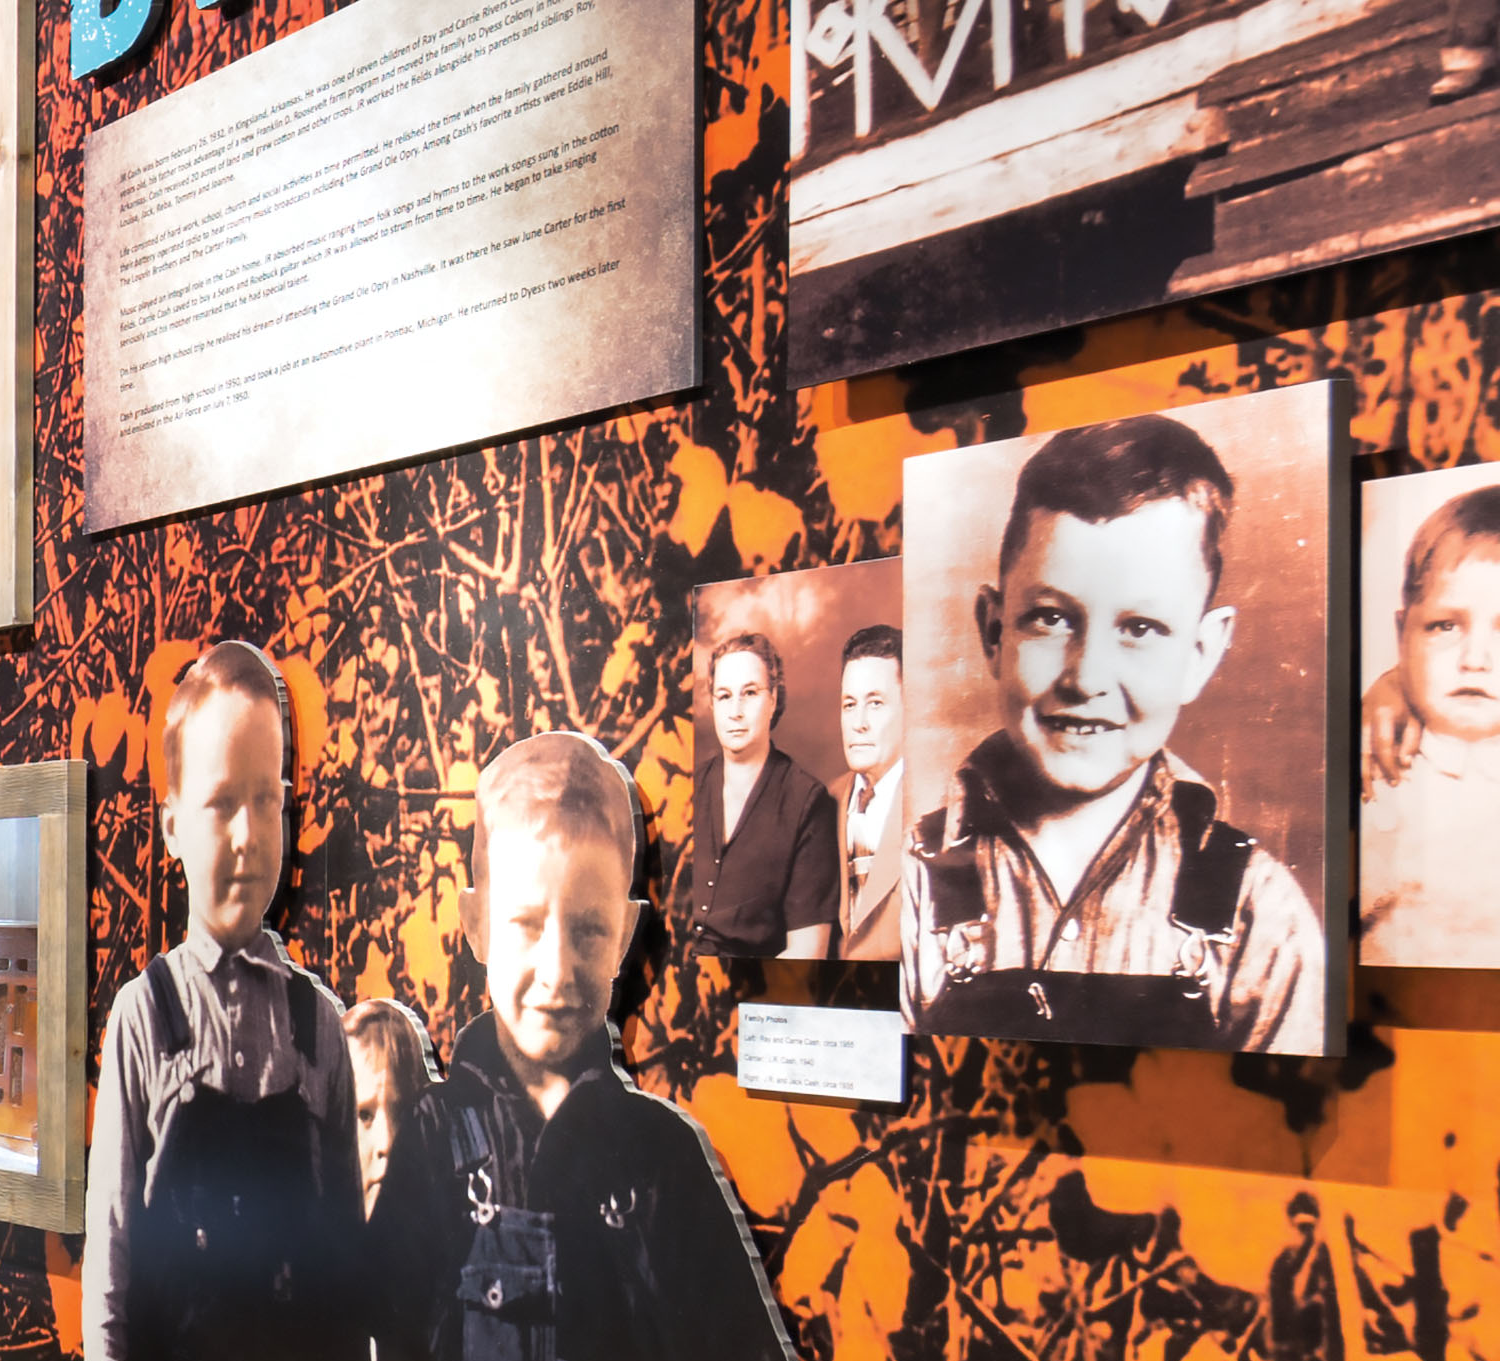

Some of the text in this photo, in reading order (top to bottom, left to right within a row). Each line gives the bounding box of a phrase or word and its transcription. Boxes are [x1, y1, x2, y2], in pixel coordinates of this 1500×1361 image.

[396, 0, 595, 93] the fields alongside his parents and siblings Roy,
[397, 53, 423, 75] moved
[425, 48, 438, 62] the
[440, 36, 465, 56] family
[467, 32, 476, 44] to
[478, 21, 502, 39] Dyess
[504, 7, 533, 27] Colony
[536, 1, 544, 13] in
[412, 38, 420, 51] of
[422, 33, 436, 47] Ray
[438, 22, 453, 39] and
[455, 12, 479, 32] Carrie
[482, 0, 507, 19] Rivers
[384, 66, 613, 168] Ole Opry. Among Cash's favorite artists were Eddie Hill,
[394, 47, 608, 146] relished the time when the family gathered around
[376, 123, 619, 222] folk songs and hymns to the work songs sung in the cotton
[380, 151, 597, 238] to strum from time to time. He began to take singing
[370, 196, 625, 293] Opry in Nashville. It was there he saw June Carter for the first
[375, 258, 621, 343] in Pontiac, Michigan. He returned to Dyess two weeks later
[765, 1015, 787, 1024] Photos
